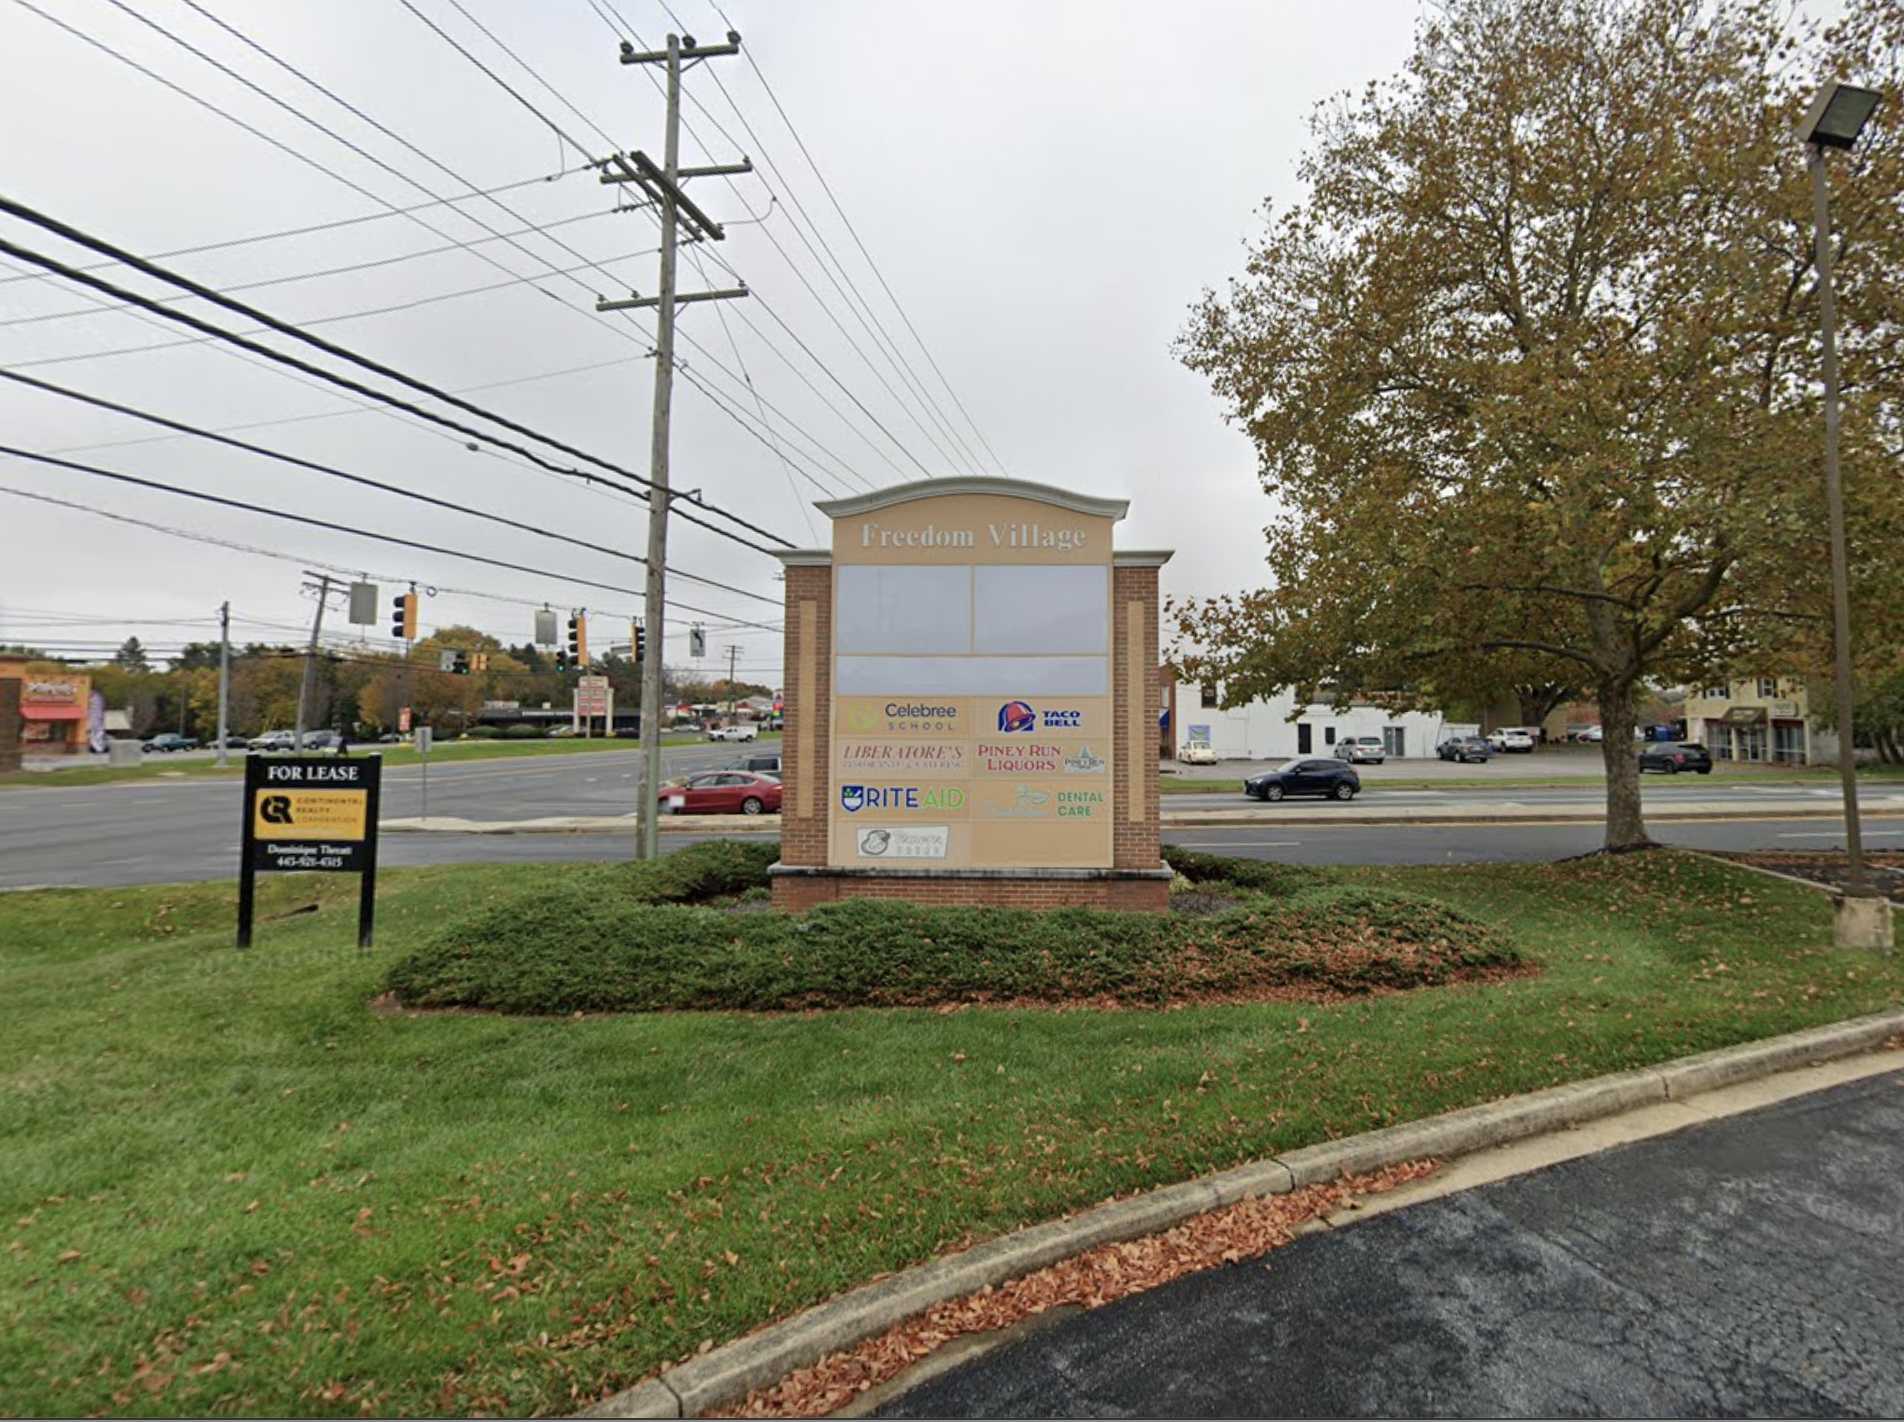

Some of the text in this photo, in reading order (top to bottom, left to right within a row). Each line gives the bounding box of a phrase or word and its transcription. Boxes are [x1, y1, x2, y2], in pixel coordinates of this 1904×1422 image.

[861, 523, 1087, 550] Freedom Village
[885, 703, 957, 718] Celebree
[1042, 710, 1081, 719] TACO
[888, 722, 954, 731] SCHOOL
[1044, 719, 1081, 728] BELL
[978, 744, 1061, 758] PINEY RUN
[987, 759, 1056, 772] LIQUORS
[268, 766, 359, 780] FOR LEASE
[866, 788, 966, 809] RITE AID
[1057, 791, 1104, 802] DENTAL
[1057, 805, 1091, 817] CARE
